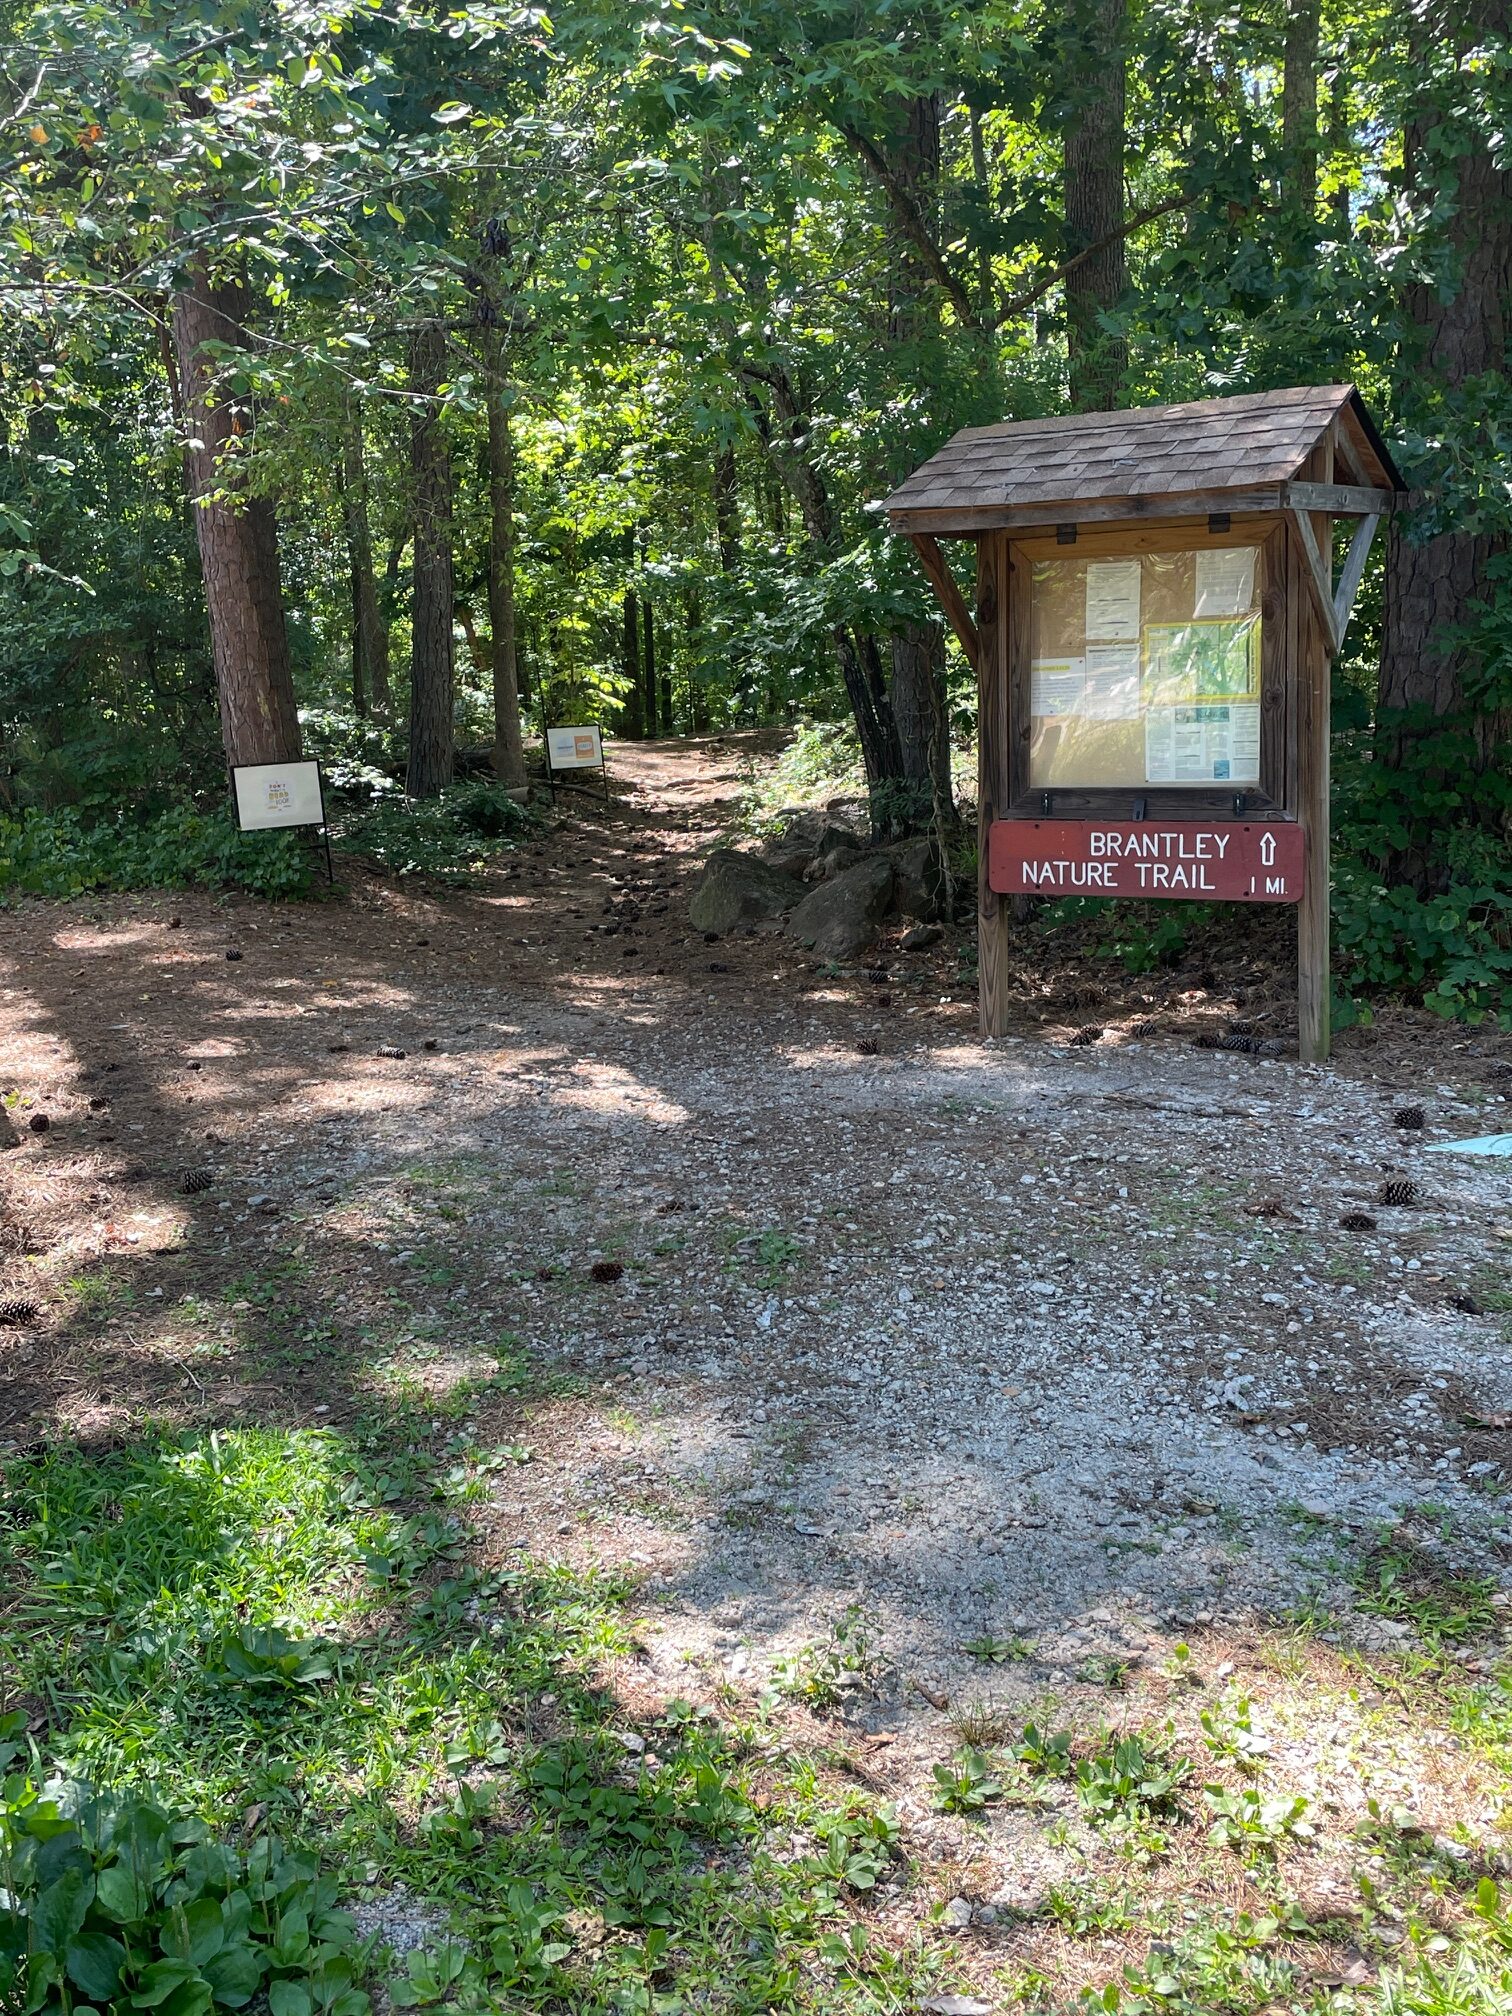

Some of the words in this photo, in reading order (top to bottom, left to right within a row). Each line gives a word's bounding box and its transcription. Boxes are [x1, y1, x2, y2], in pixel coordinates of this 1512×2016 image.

[1090, 832, 1230, 859] BRANTLEY
[1022, 861, 1119, 887] NATURE
[1134, 863, 1216, 890] TRAIL
[1266, 877, 1289, 895] MI.
